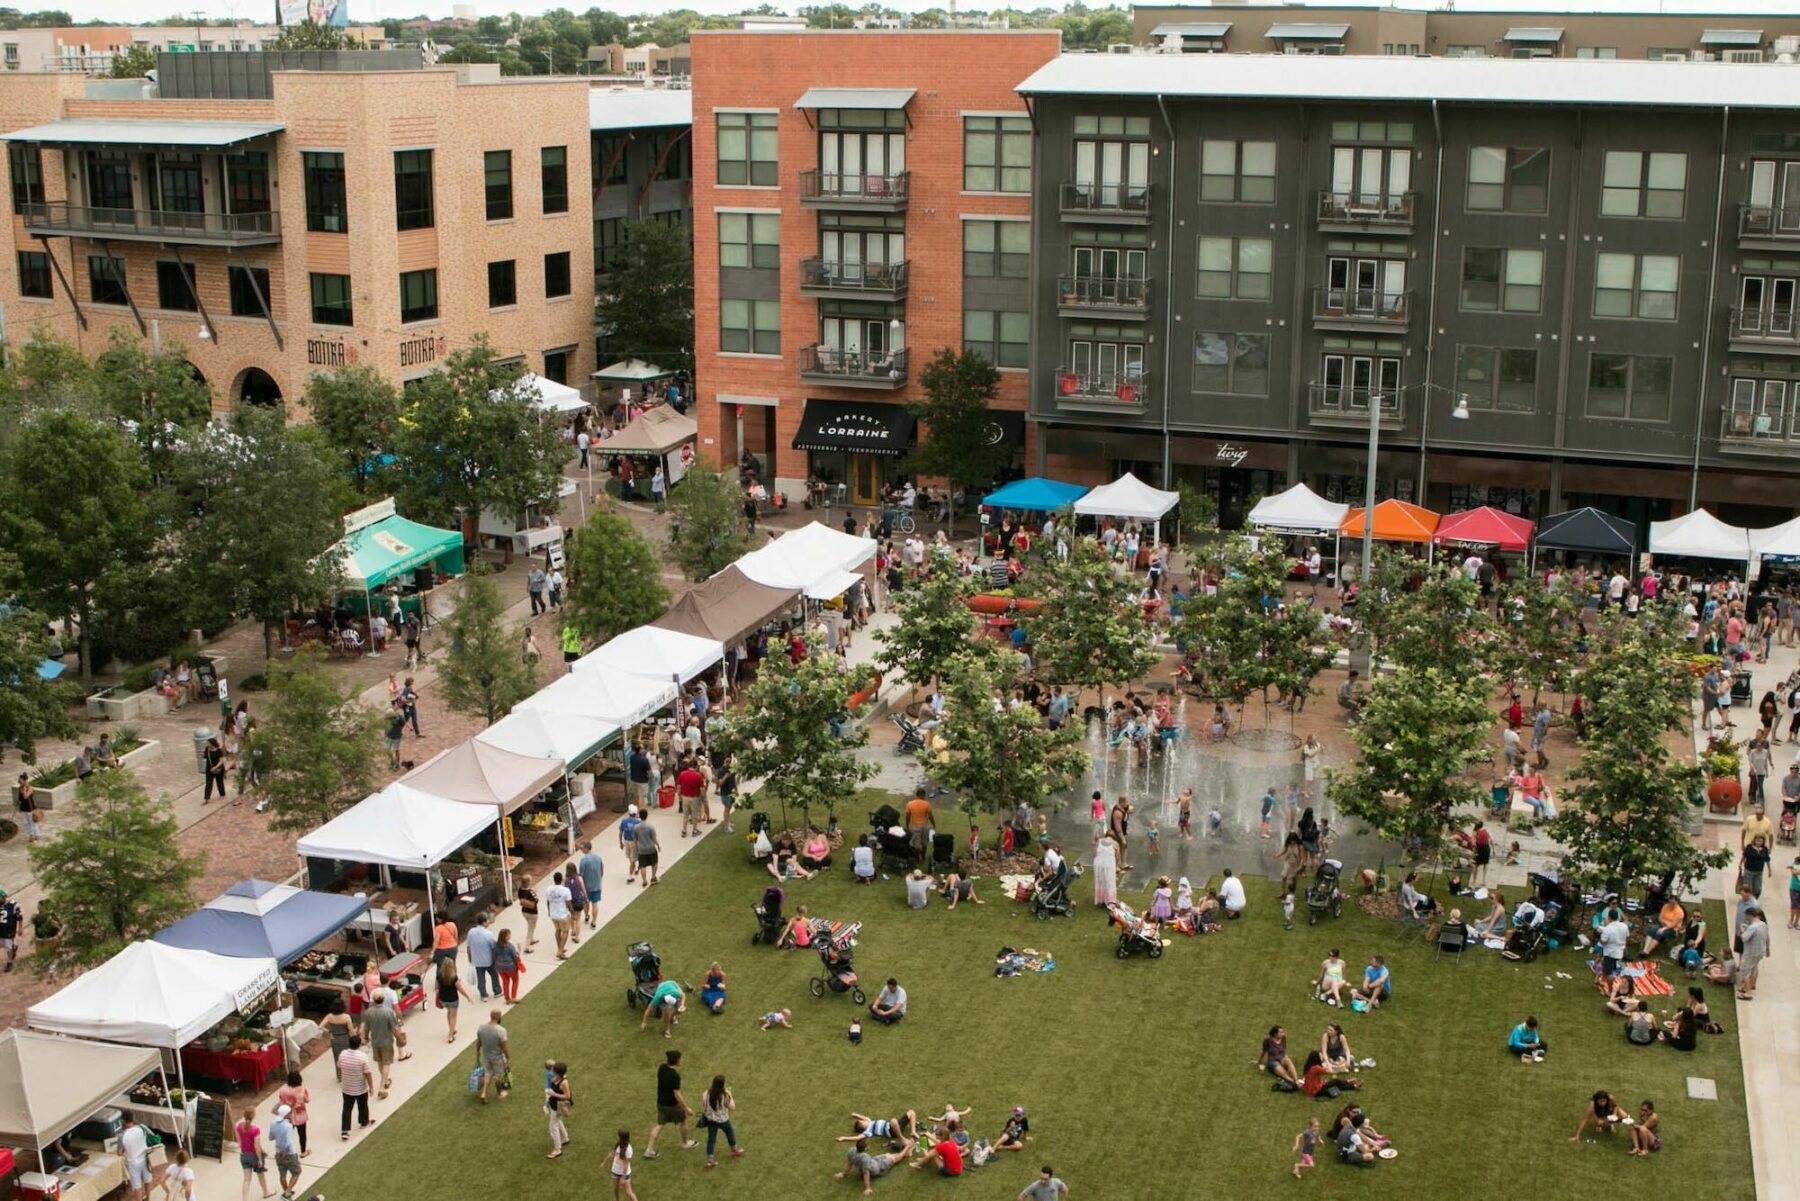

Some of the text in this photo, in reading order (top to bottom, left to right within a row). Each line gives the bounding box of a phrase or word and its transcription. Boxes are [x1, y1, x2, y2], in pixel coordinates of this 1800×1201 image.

[307, 339, 345, 366] BOTIKA
[400, 337, 435, 367] BOTIKA
[818, 426, 889, 438] LORRAINE
[836, 414, 880, 425] BAKERY
[1217, 443, 1248, 467] twig
[237, 968, 270, 998] GRASS FED
